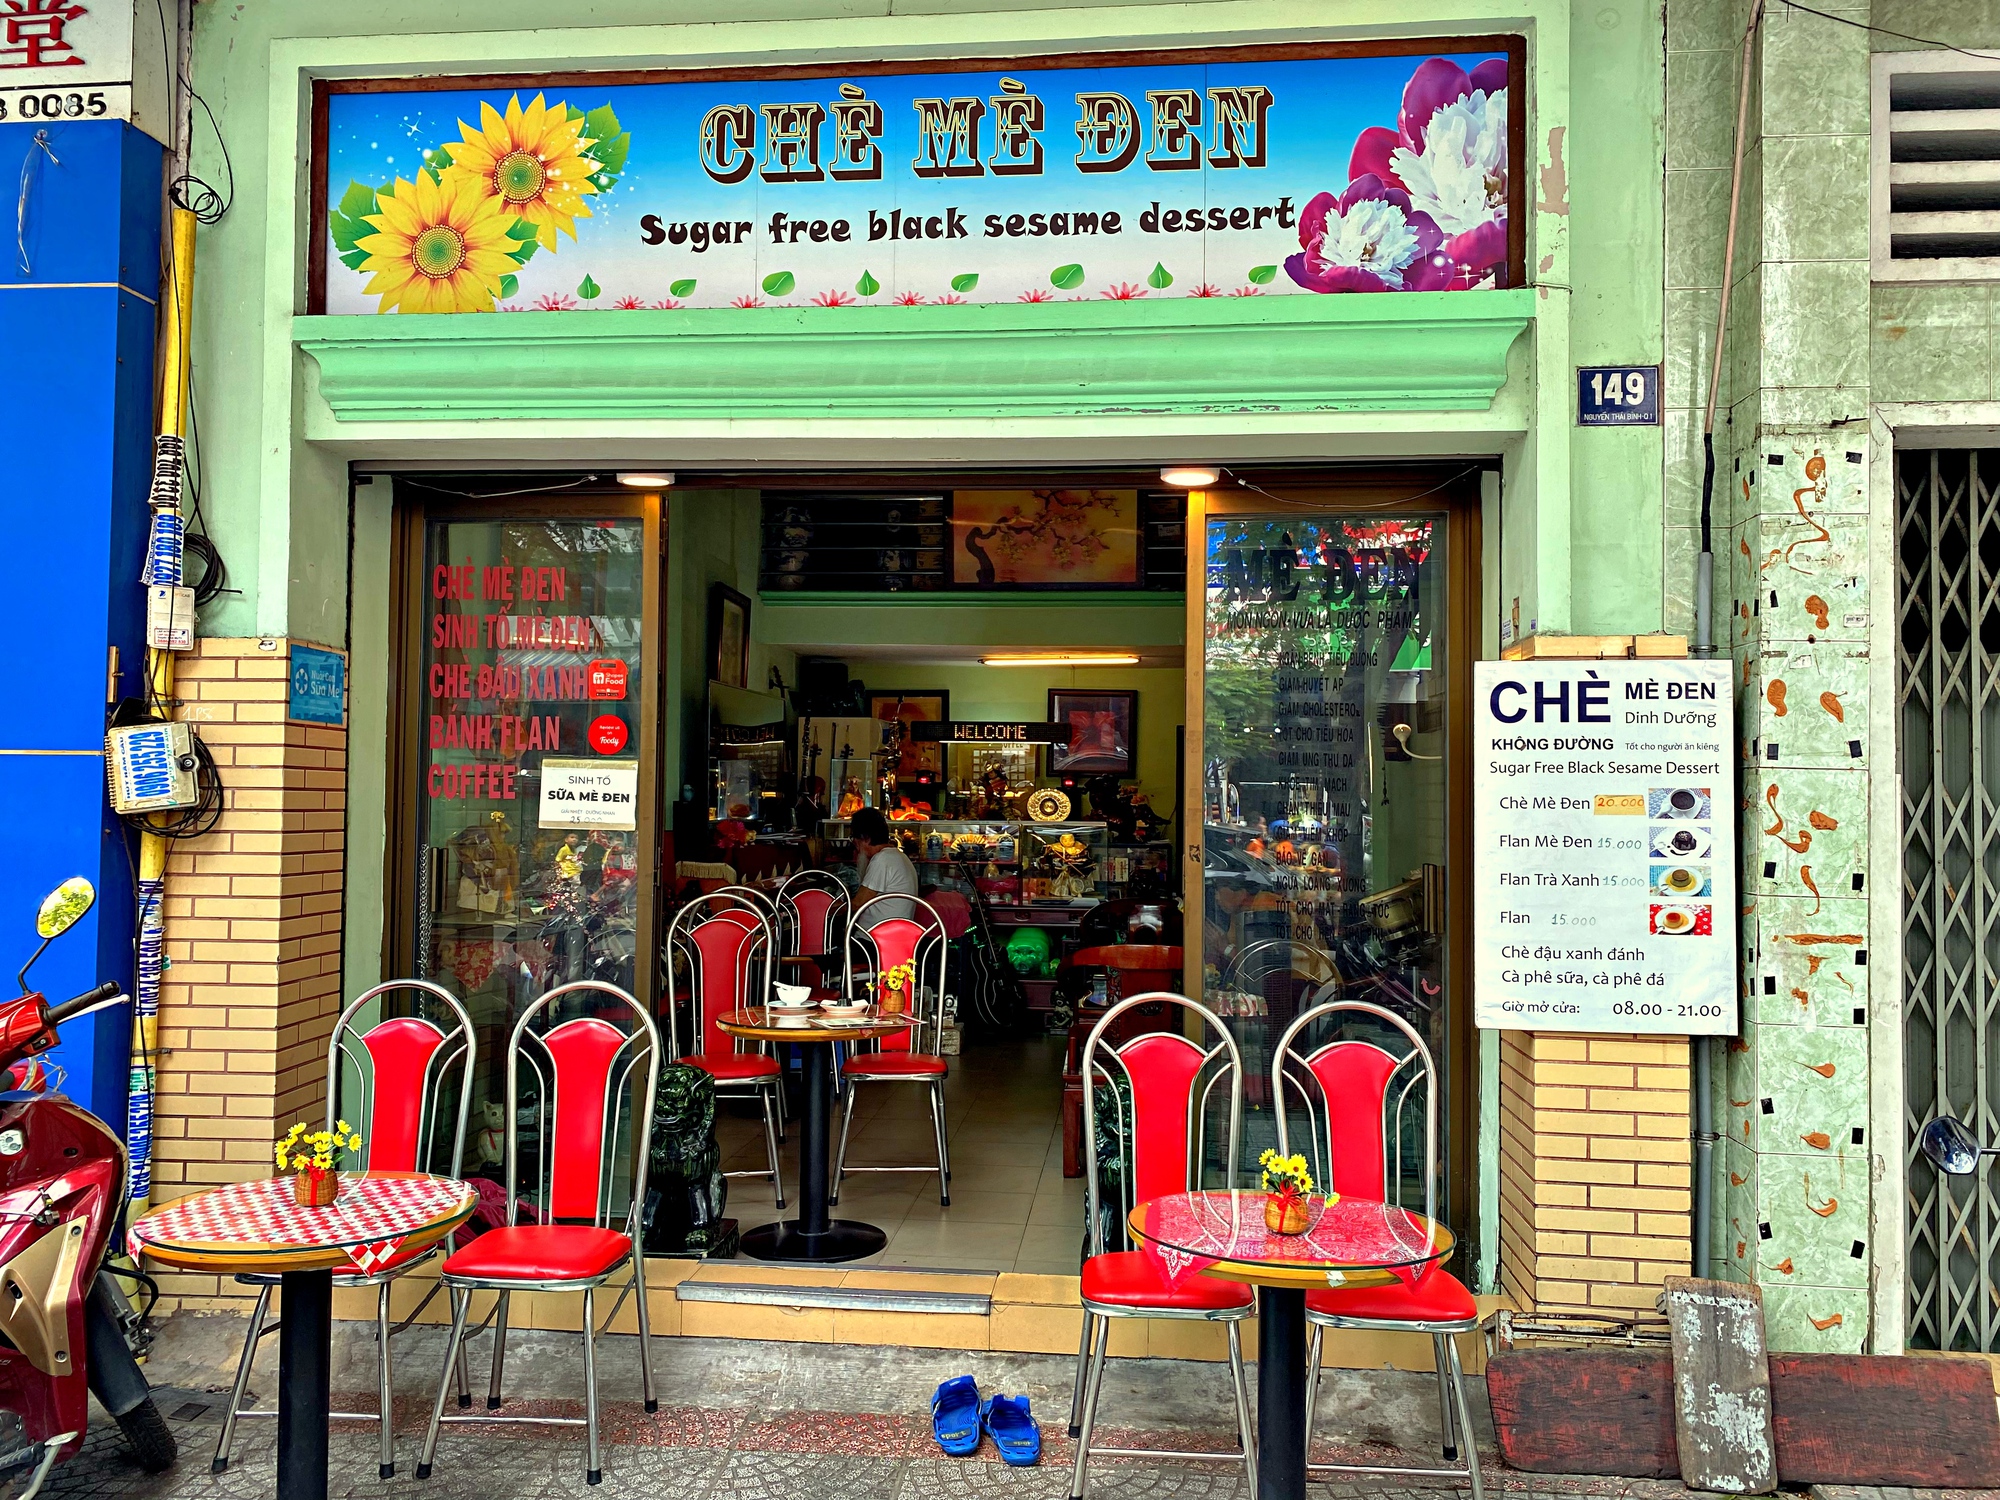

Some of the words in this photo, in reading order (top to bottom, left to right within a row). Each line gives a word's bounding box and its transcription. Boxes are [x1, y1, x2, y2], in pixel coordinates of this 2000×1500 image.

[0, 0, 88, 69] 堂
[19, 92, 107, 118] 0085
[698, 82, 883, 184] CHÈ
[913, 77, 1044, 179] MÈ
[1075, 86, 1274, 173] ĐEN
[639, 213, 754, 253] Sugar
[769, 203, 852, 244] free
[867, 206, 968, 241] black
[984, 207, 1122, 238] sesame
[1139, 196, 1296, 234] dessert
[1590, 372, 1645, 406] 149
[433, 556, 475, 600] CHÈ
[482, 557, 514, 600] MÈ
[521, 566, 565, 601] ĐEN
[432, 613, 478, 649] SINH
[485, 603, 513, 650] TỐ
[516, 607, 546, 650] MÈ
[550, 616, 590, 651] ĐEN
[429, 655, 472, 699] CHÈ
[478, 654, 522, 706] ĐẬU
[527, 665, 588, 699] XANH
[1490, 670, 1611, 723] CHÈ
[1625, 678, 1660, 700] MÈ
[1666, 682, 1716, 700] ĐEN
[429, 704, 491, 749] BÁNH
[501, 715, 560, 750] FLAN
[1625, 711, 1659, 724] Dinh
[1664, 711, 1717, 728] Dưỡng
[954, 724, 1027, 740] WELCOME
[599, 736, 619, 747] Foody
[1491, 737, 1549, 750] KHÔNG
[1553, 735, 1614, 750] ĐƯỜNG
[1625, 742, 1639, 751] Tốt
[1640, 742, 1656, 751] cho
[1657, 742, 1683, 753] người
[1490, 762, 1531, 776] Sugar
[1534, 762, 1564, 774] Free
[1568, 761, 1605, 774] Black
[1608, 762, 1662, 774] Sesame
[1666, 762, 1720, 774] Dessert
[428, 763, 517, 800] COFFEE
[568, 775, 594, 785] SINH
[597, 775, 611, 786] TỐ
[548, 788, 575, 801] SỮA
[579, 790, 598, 802] MÈ
[602, 792, 630, 803] ĐEN
[1499, 796, 1528, 809] Chè
[1532, 796, 1556, 809] Mè
[1560, 797, 1591, 809] Đen
[1597, 797, 1644, 808] 20.000
[1499, 835, 1531, 848] Flan
[1534, 835, 1559, 848] Mè
[1563, 835, 1592, 848] Đen
[1597, 837, 1642, 849] 15.000
[1500, 873, 1530, 886] Flan
[1534, 873, 1557, 886] Trà
[1561, 873, 1600, 886] Xanh
[1602, 876, 1645, 888] 15.000
[1500, 911, 1530, 924] Flan
[1551, 914, 1596, 926] 15.000
[1501, 946, 1529, 959] Chè
[1534, 946, 1562, 962] đậu
[1566, 947, 1603, 960] xanh
[1607, 947, 1645, 961] đánh
[1501, 970, 1520, 983] Cà
[1524, 971, 1552, 986] phê
[1556, 971, 1588, 987] sữa,
[1593, 972, 1609, 985] cà
[1613, 972, 1642, 988] phê
[1646, 972, 1665, 986] đá
[1502, 1001, 1525, 1013] Giờ
[1527, 1001, 1550, 1013] mở
[1552, 1001, 1580, 1014] cửa:
[1613, 1001, 1662, 1016] 08.00
[1677, 1003, 1721, 1017] 21.00
[941, 1430, 966, 1440] sport
